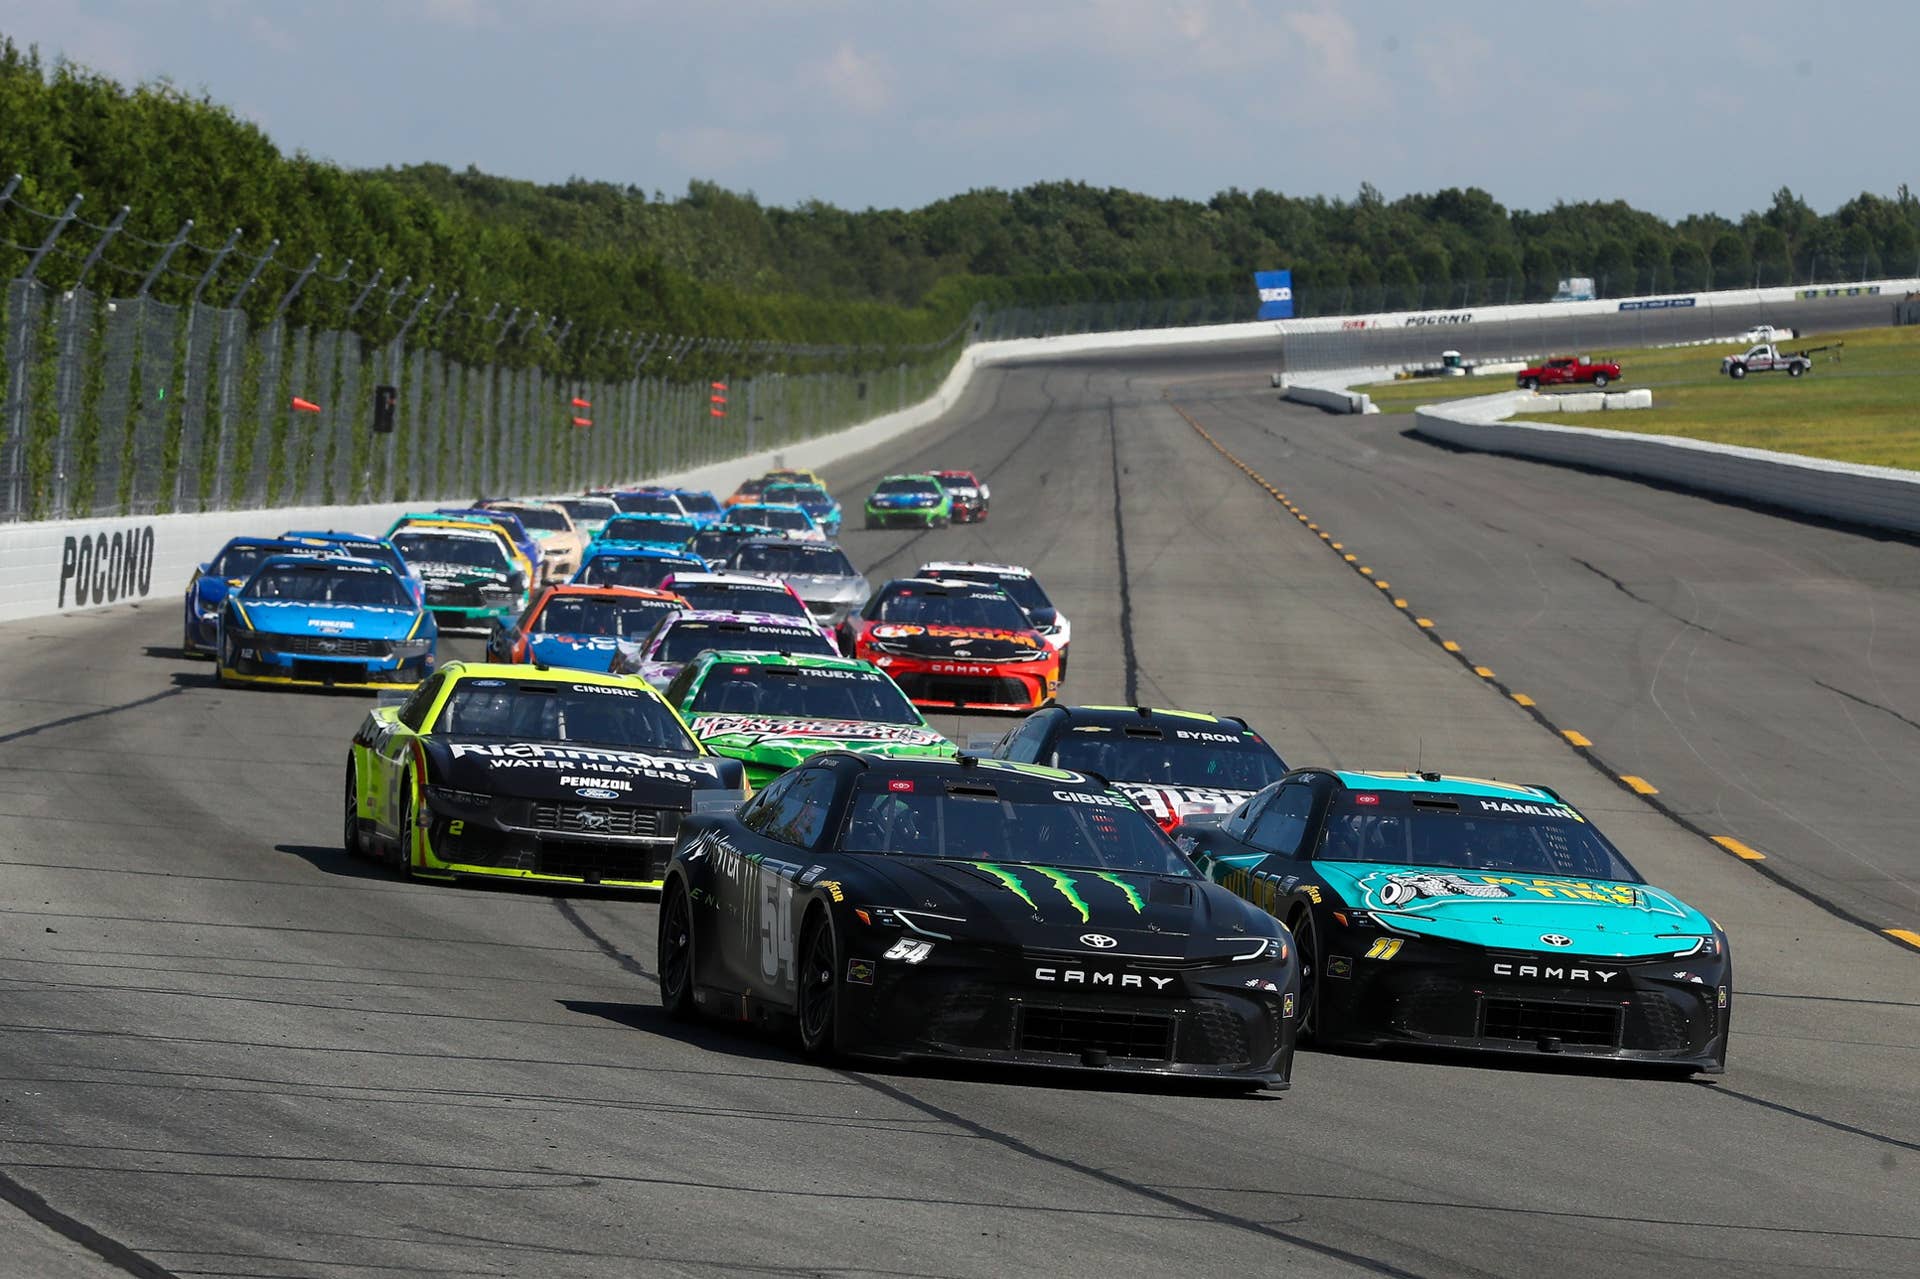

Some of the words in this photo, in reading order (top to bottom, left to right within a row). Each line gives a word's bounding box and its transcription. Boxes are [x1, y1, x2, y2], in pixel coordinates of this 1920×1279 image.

[1405, 314, 1472, 326] POCONO
[58, 526, 155, 609] POCONO
[969, 592, 1007, 601] JONES
[641, 600, 683, 611] SMITH
[749, 625, 812, 637] BOWMAN
[800, 667, 856, 680] TRUEX
[860, 671, 881, 682] JR
[931, 664, 993, 674] CAMRY
[572, 683, 639, 698] CINDRIC
[1176, 729, 1240, 744] BYRON
[490, 758, 575, 771] WATER
[582, 761, 692, 784] HEATERS
[560, 776, 633, 791] PENNZOIL
[1052, 790, 1125, 808] GIBBS
[1480, 800, 1573, 819] HAMLIN
[448, 819, 464, 836] 2
[883, 937, 935, 965] 54
[1364, 936, 1405, 960] 11
[1035, 967, 1174, 990] CAMRY
[1493, 963, 1619, 983] CAMRY
